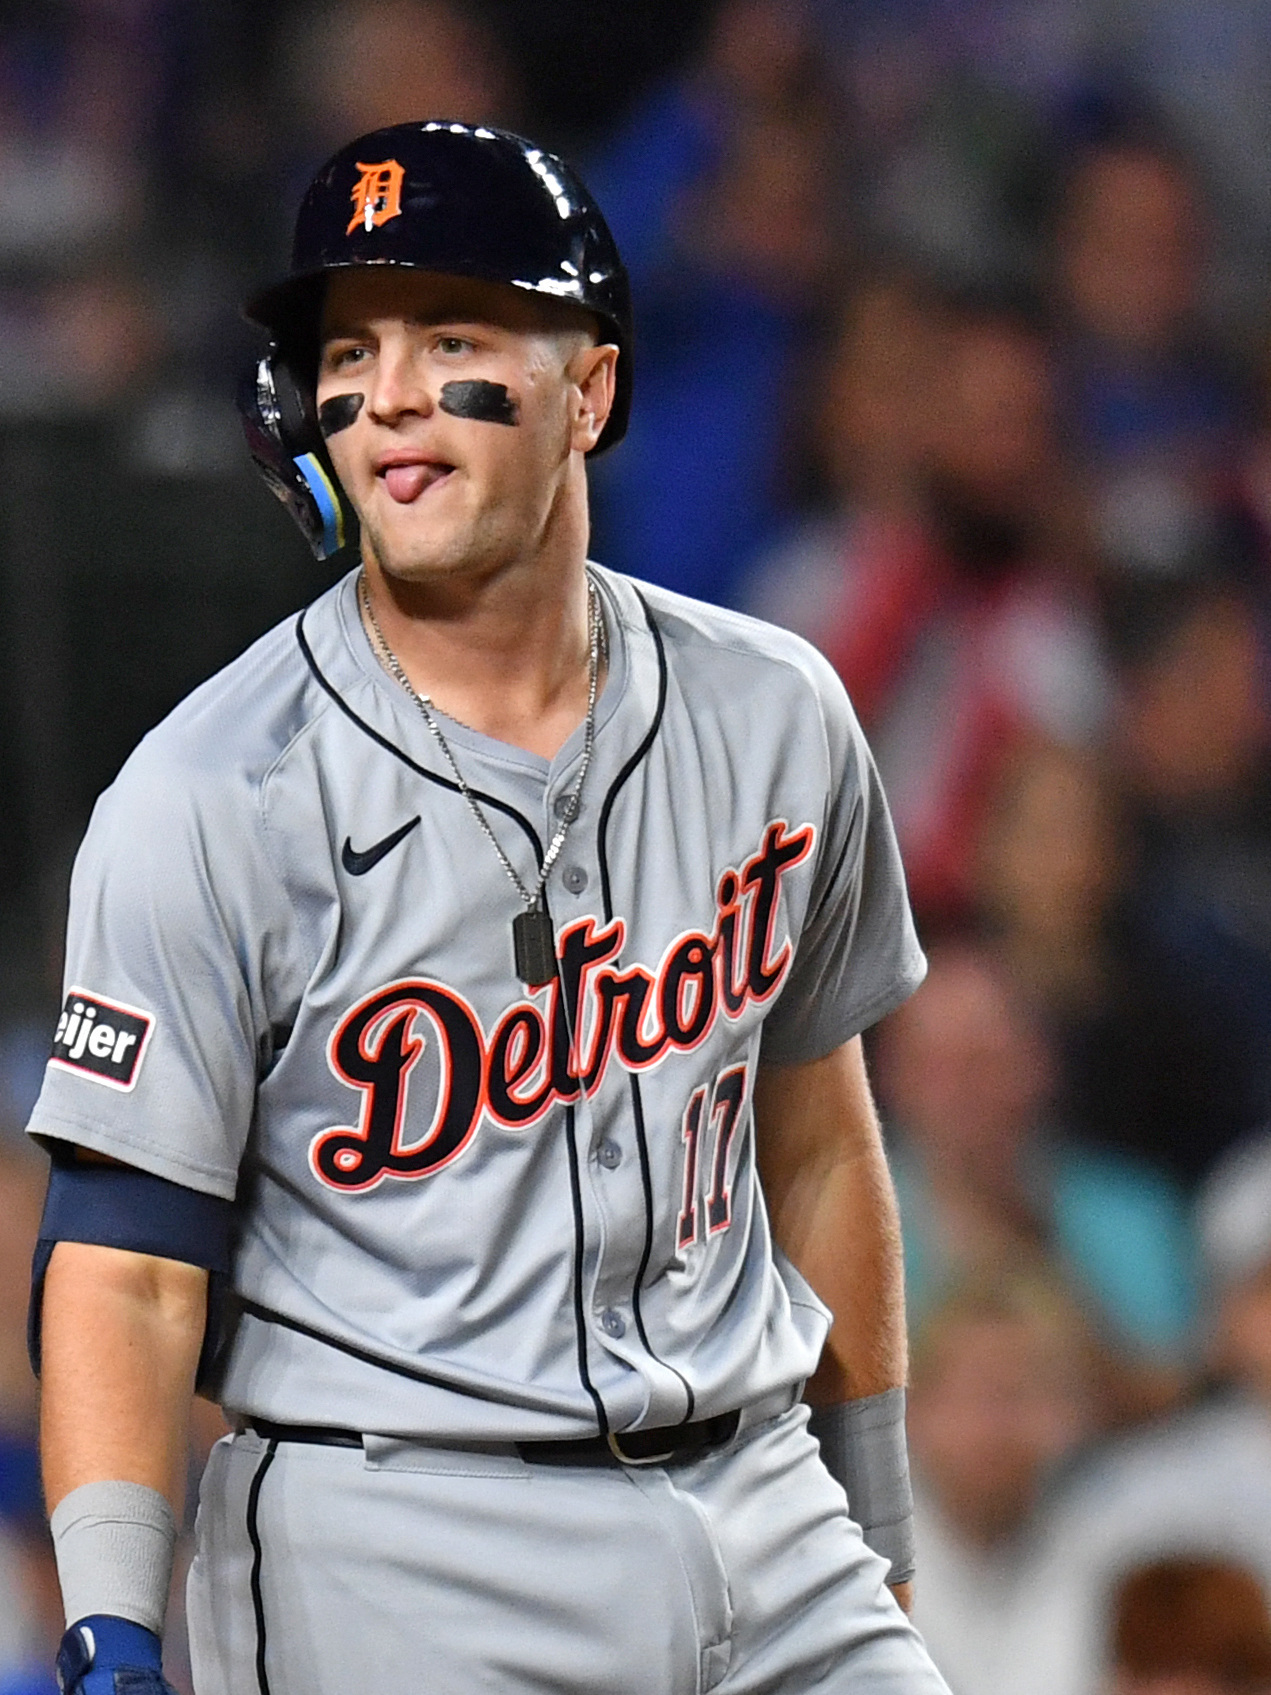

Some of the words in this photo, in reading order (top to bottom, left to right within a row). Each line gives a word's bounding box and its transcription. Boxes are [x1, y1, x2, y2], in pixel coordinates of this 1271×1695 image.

[345, 158, 406, 236] D
[309, 820, 816, 1194] Detroit
[676, 1063, 747, 1255] 17
